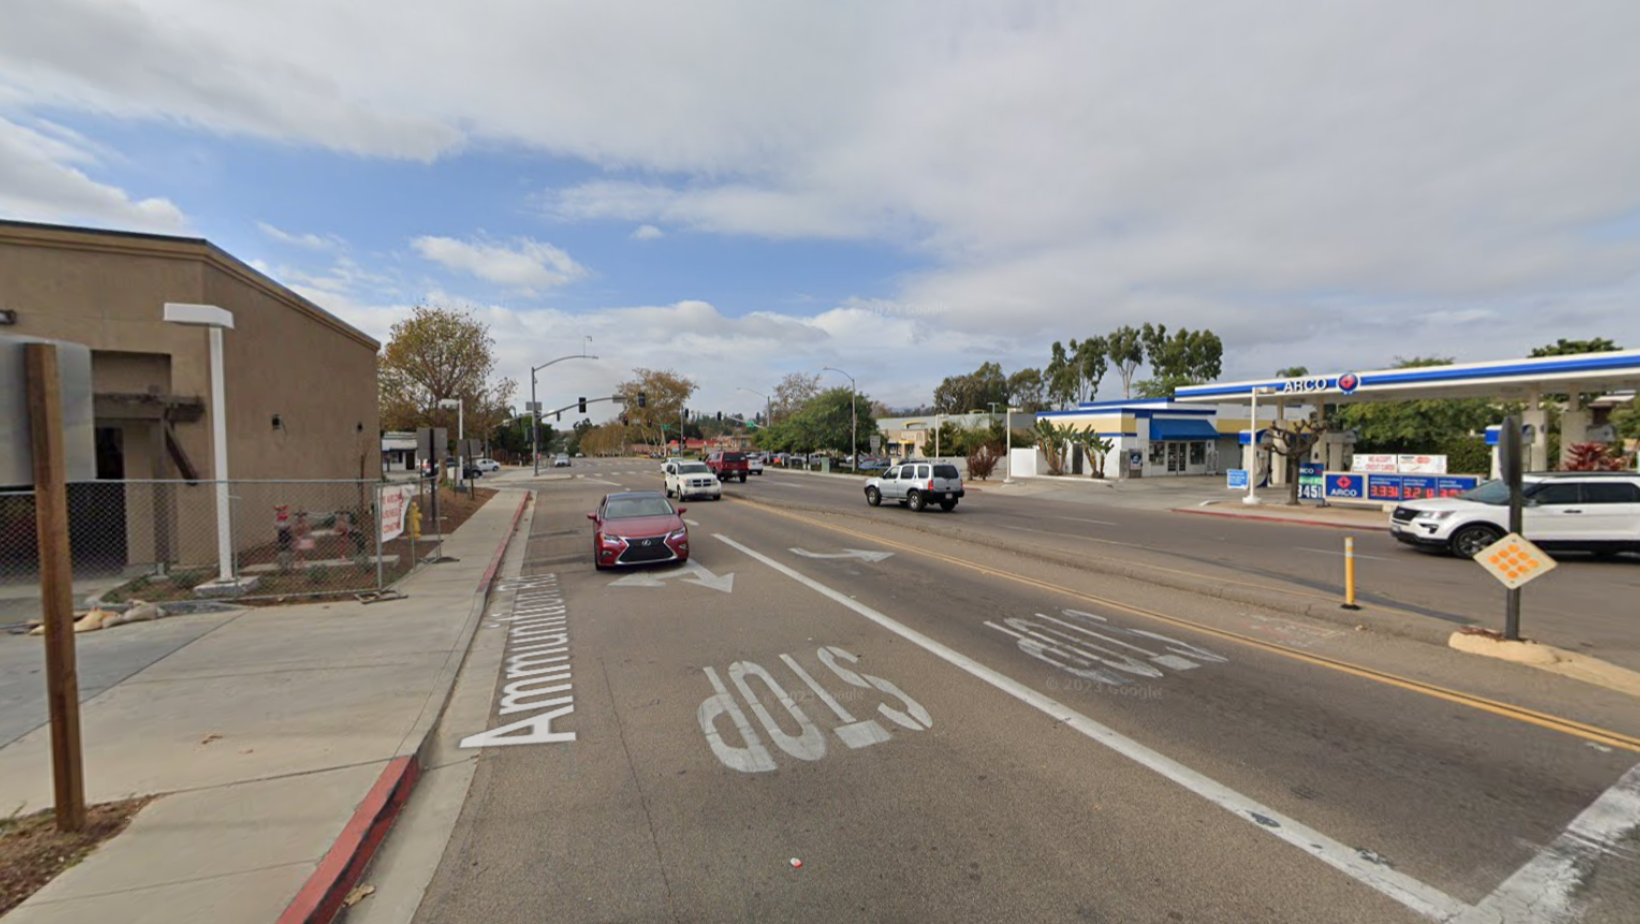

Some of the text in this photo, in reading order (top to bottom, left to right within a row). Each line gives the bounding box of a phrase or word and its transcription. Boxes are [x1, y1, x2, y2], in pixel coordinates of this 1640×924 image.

[1284, 378, 1327, 392] ARCO
[1330, 489, 1357, 497] ARCO
[697, 645, 933, 774] STOP
